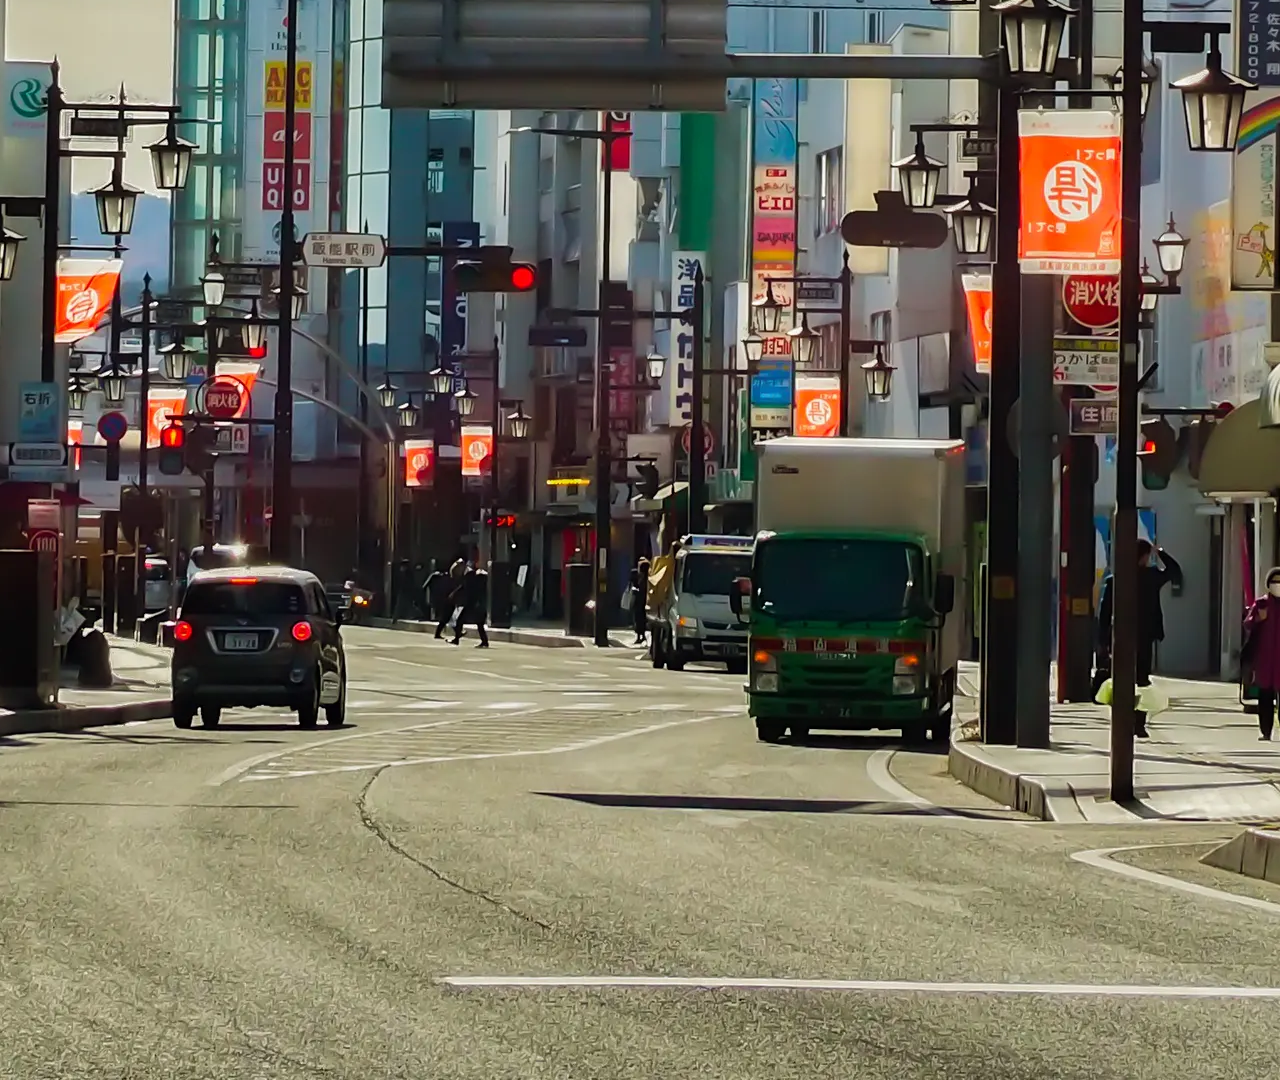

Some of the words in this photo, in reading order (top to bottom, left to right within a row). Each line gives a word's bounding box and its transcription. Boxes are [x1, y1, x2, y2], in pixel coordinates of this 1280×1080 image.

[266, 66, 311, 89] AC
[267, 168, 303, 185] UI
[267, 188, 307, 208] QO
